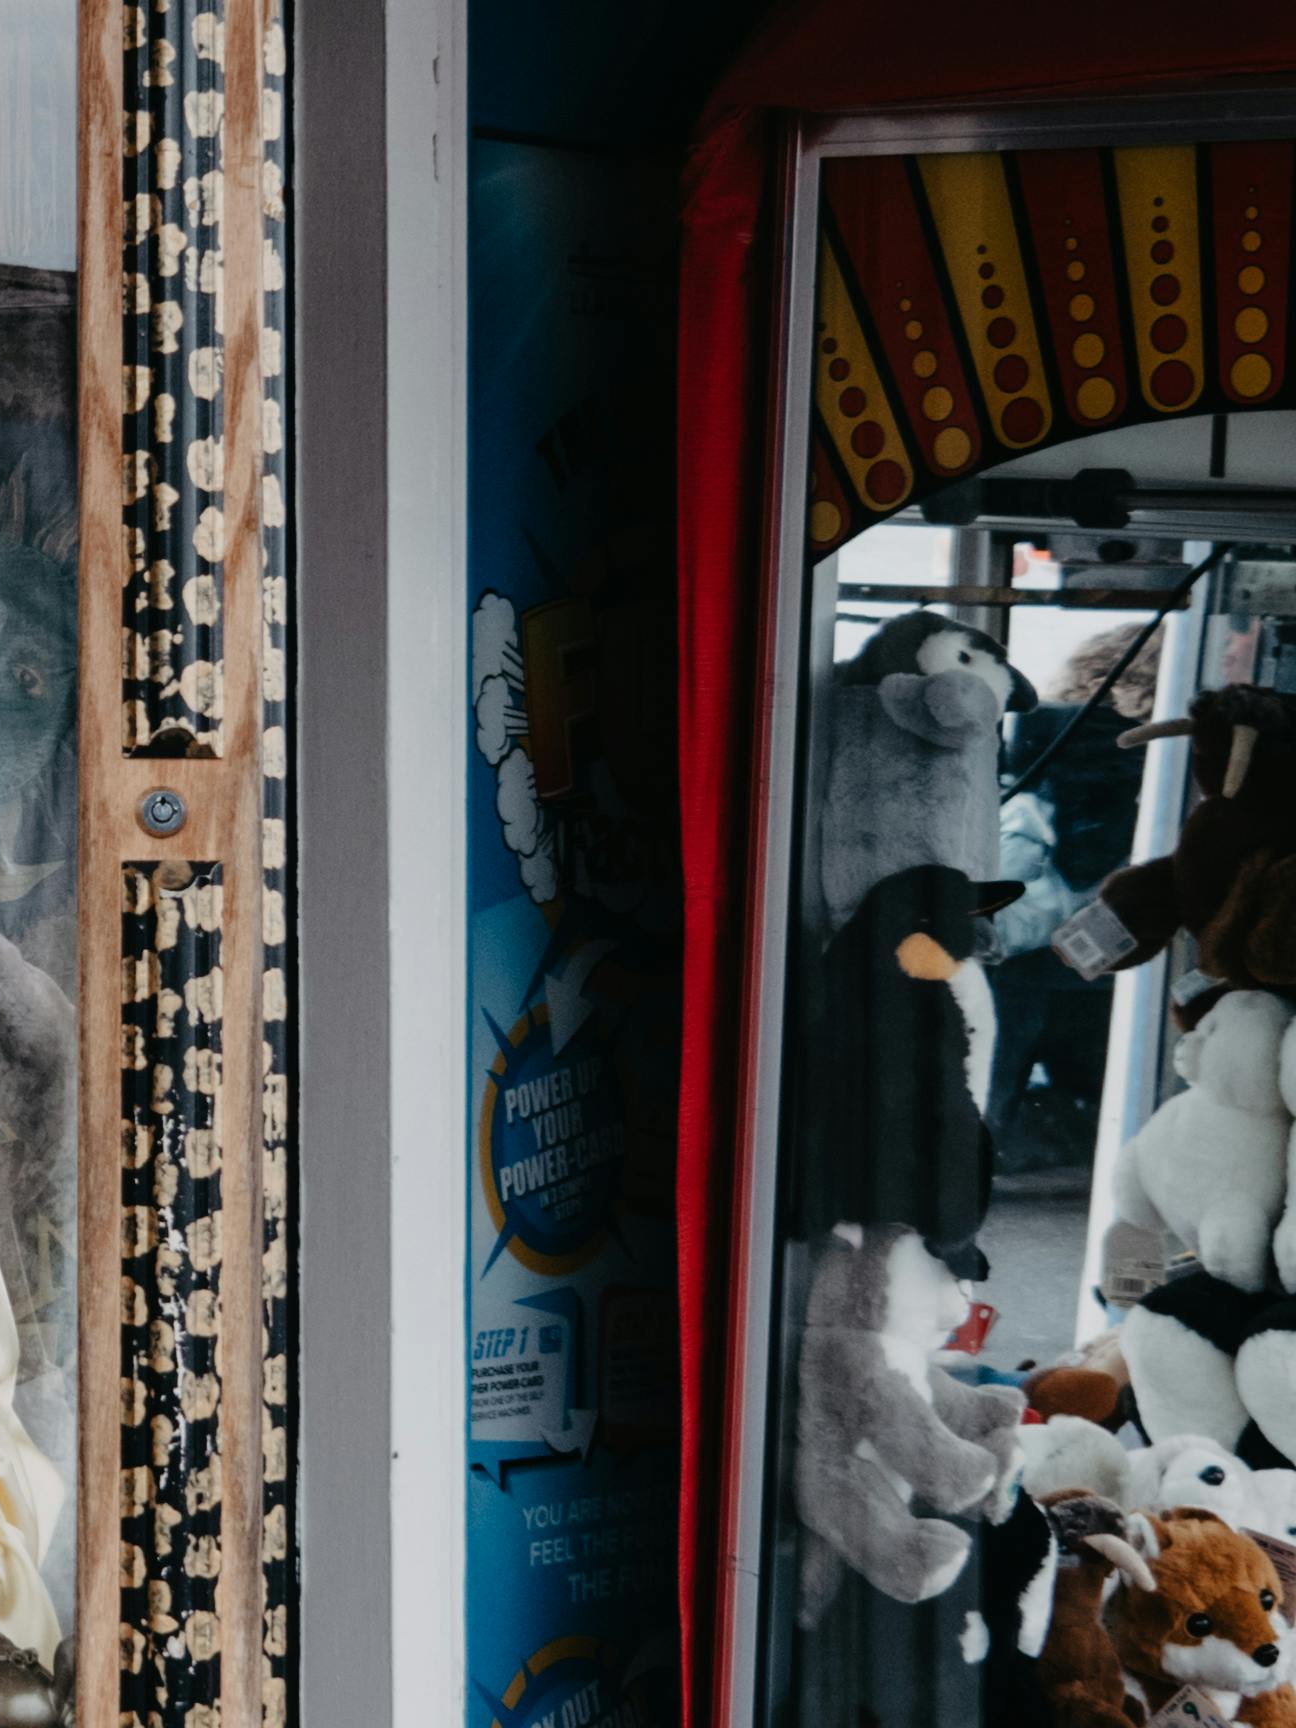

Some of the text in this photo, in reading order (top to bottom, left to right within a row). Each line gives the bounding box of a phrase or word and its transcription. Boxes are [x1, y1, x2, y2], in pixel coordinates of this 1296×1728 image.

[504, 1067, 574, 1124] POWER
[531, 1101, 584, 1151] YOUR
[499, 1120, 625, 1202] POWER-CARD
[473, 1326, 530, 1360] STEP 1
[516, 1360, 539, 1372] YOUR
[522, 1502, 563, 1531] YOU
[529, 1536, 576, 1568] FEEL
[566, 1569, 614, 1603] THE
